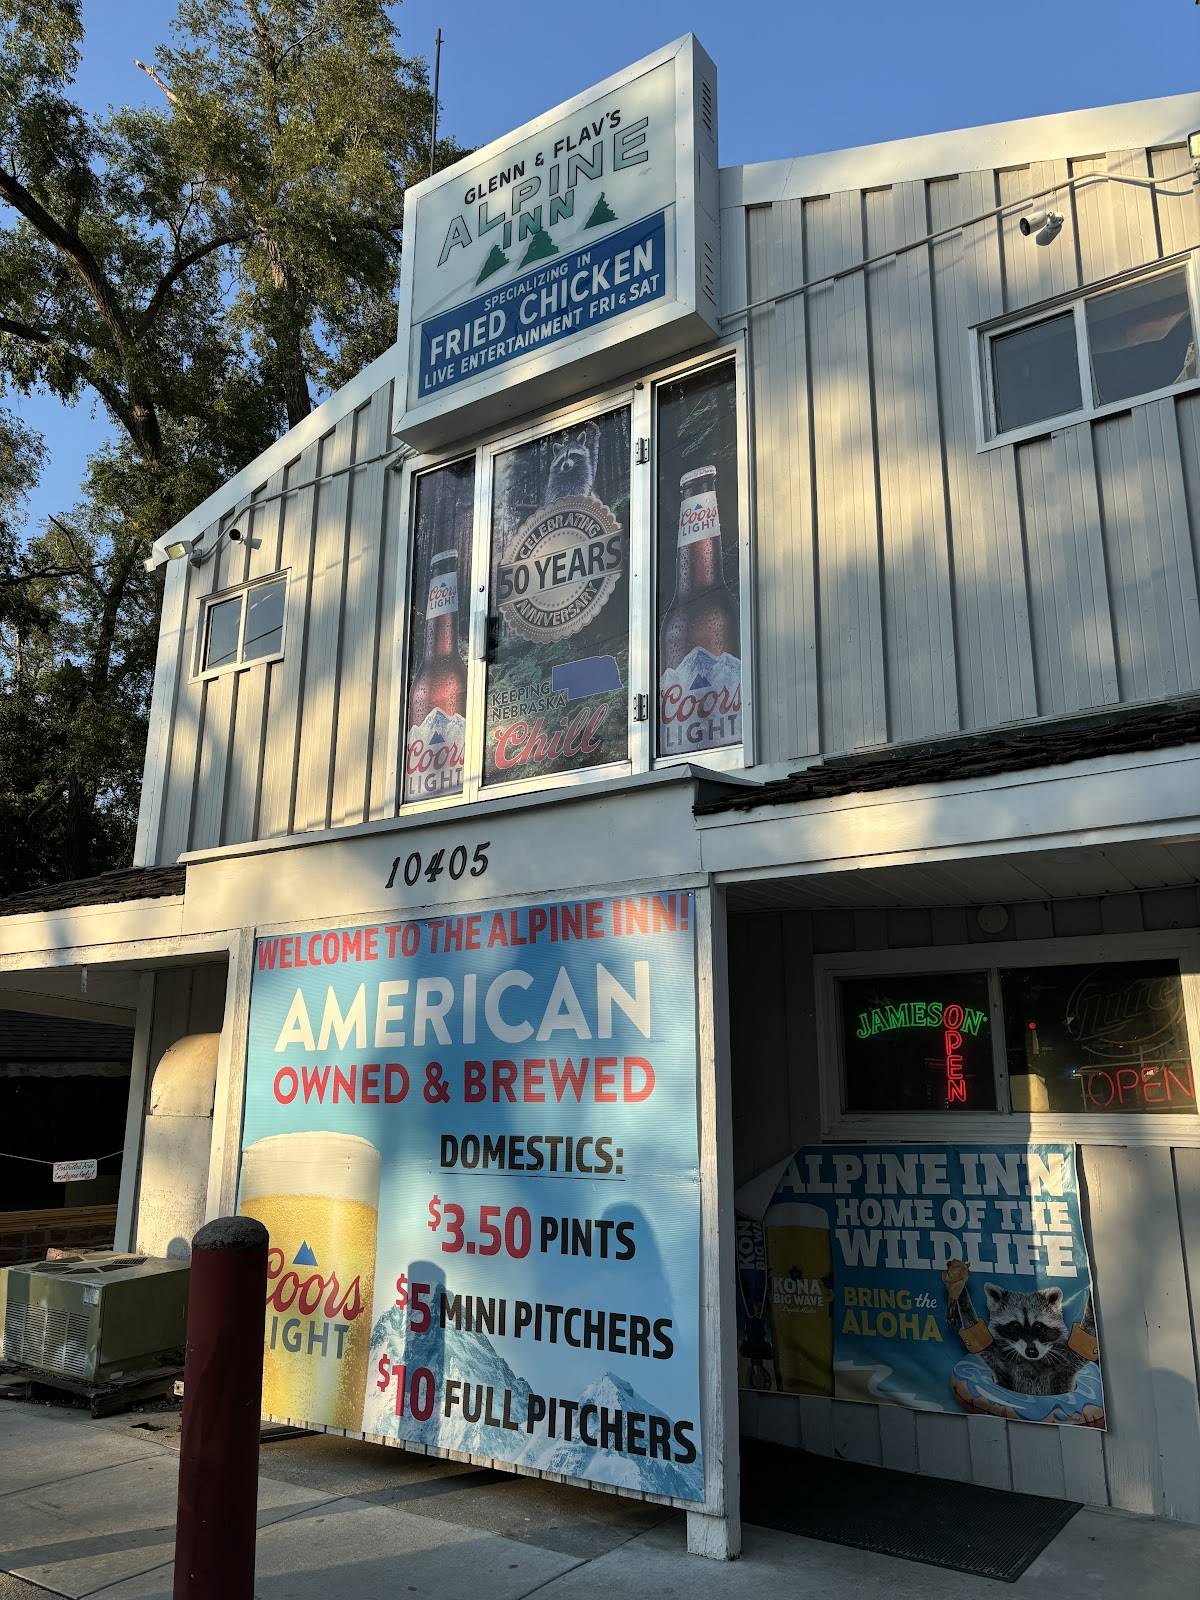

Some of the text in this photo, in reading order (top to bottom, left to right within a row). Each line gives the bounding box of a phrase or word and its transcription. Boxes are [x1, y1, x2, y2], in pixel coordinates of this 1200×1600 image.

[464, 109, 622, 205] GLENN & FLAV'S
[436, 116, 649, 267] ALPINE
[502, 189, 575, 250] INN
[430, 239, 653, 366] FRIED CHICKEN
[484, 252, 592, 309] SPECIALIZING IN
[424, 273, 660, 389] LIVE ENTERTAINMENT FRI & SAT
[518, 512, 601, 560] CELEBRATING
[680, 506, 718, 528] Coors
[682, 519, 717, 537] LIGHT
[496, 536, 622, 600] 50 YEARS
[430, 595, 456, 610] LIGHT
[517, 580, 599, 626] ANNIVERSARY
[492, 680, 550, 707] KEEPING
[492, 692, 566, 722] NEBRASKA
[661, 683, 742, 724] Coors
[495, 703, 609, 769] Chill
[666, 714, 738, 747] LIGHT
[410, 767, 463, 794] LIGHT
[385, 841, 490, 889] 10405
[258, 893, 689, 971] WELCOME TO THE ALPINE INN!
[274, 960, 651, 1053] AMERICAN
[856, 1002, 985, 1038] JAMESON
[943, 1003, 967, 1102] OPEN
[273, 1056, 655, 1105] OWNED & BREWED
[1087, 1064, 1196, 1107] OPEN
[440, 1134, 624, 1175] DOMESTICS:
[777, 1153, 1065, 1197] ALPINE INN
[427, 1194, 636, 1261] $3.50 PINTS
[752, 1216, 764, 1247] WA
[835, 1199, 1073, 1233] HOME OF THE
[835, 1229, 1078, 1278] WILDLIFE
[772, 1277, 823, 1296] KONA
[772, 1293, 825, 1308] BIG WAVE
[843, 1286, 938, 1311] BRING the
[269, 1315, 350, 1359] IGHT
[395, 1273, 674, 1360] $5 MINI PITCHERS
[842, 1311, 945, 1343] ALOHA
[376, 1353, 697, 1465] $10 FULL PITCHERS
